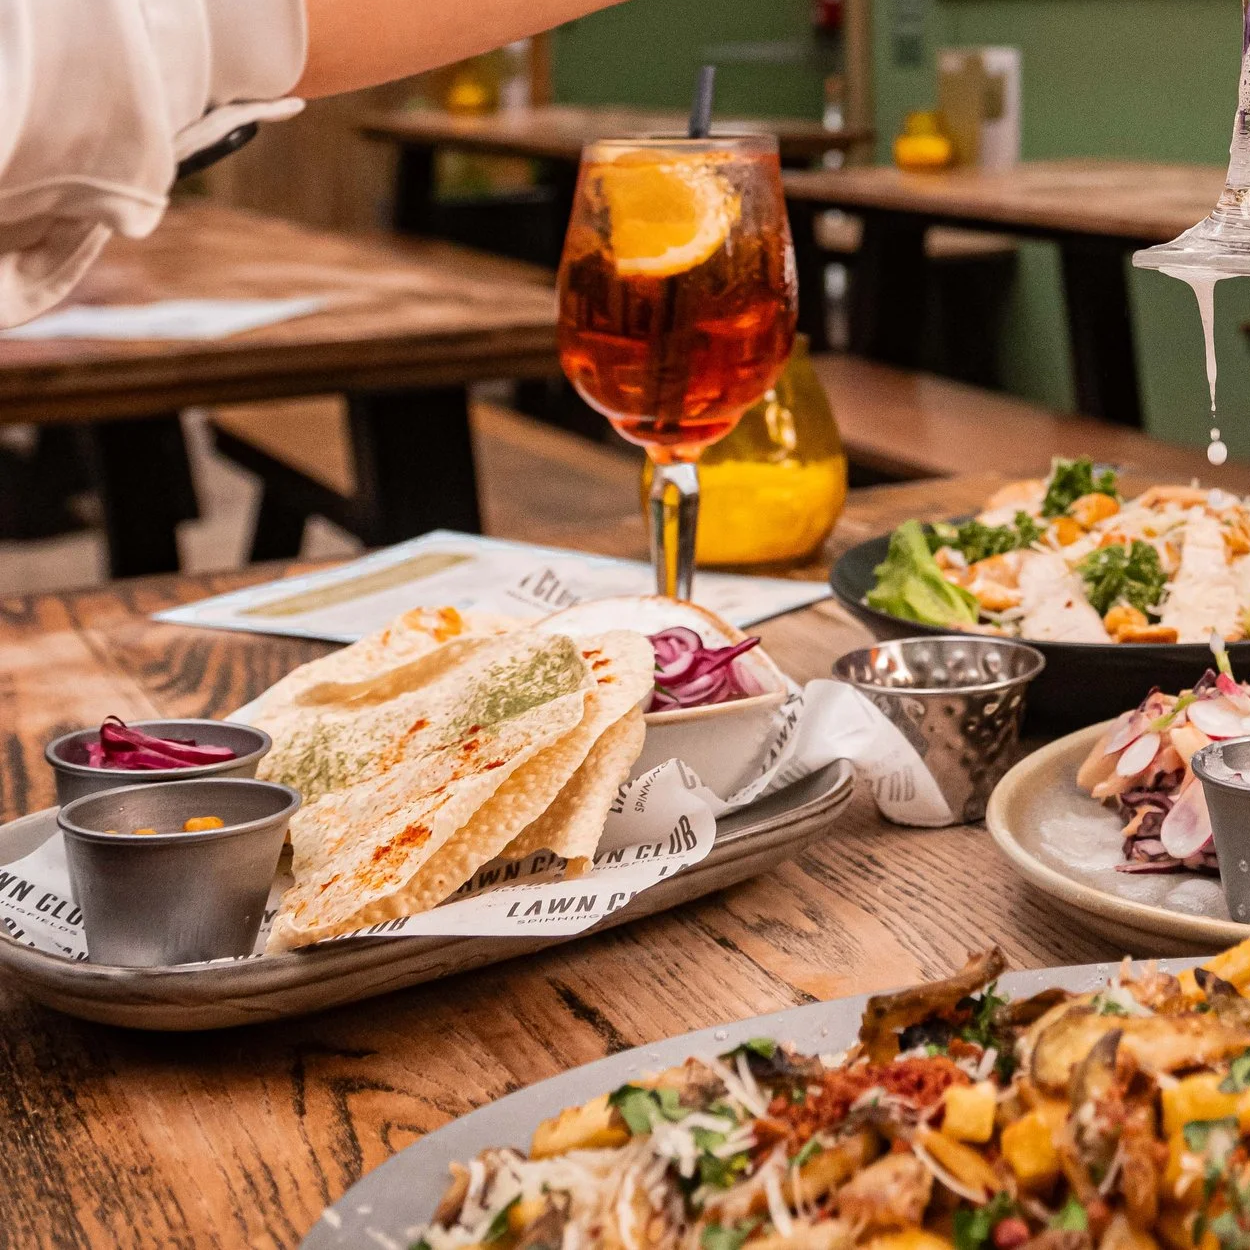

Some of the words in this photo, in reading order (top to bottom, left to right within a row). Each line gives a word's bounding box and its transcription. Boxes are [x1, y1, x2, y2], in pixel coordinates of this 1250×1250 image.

[635, 814, 698, 857] CLUB
[35, 892, 85, 929] CLU
[506, 894, 598, 918] LAWN
